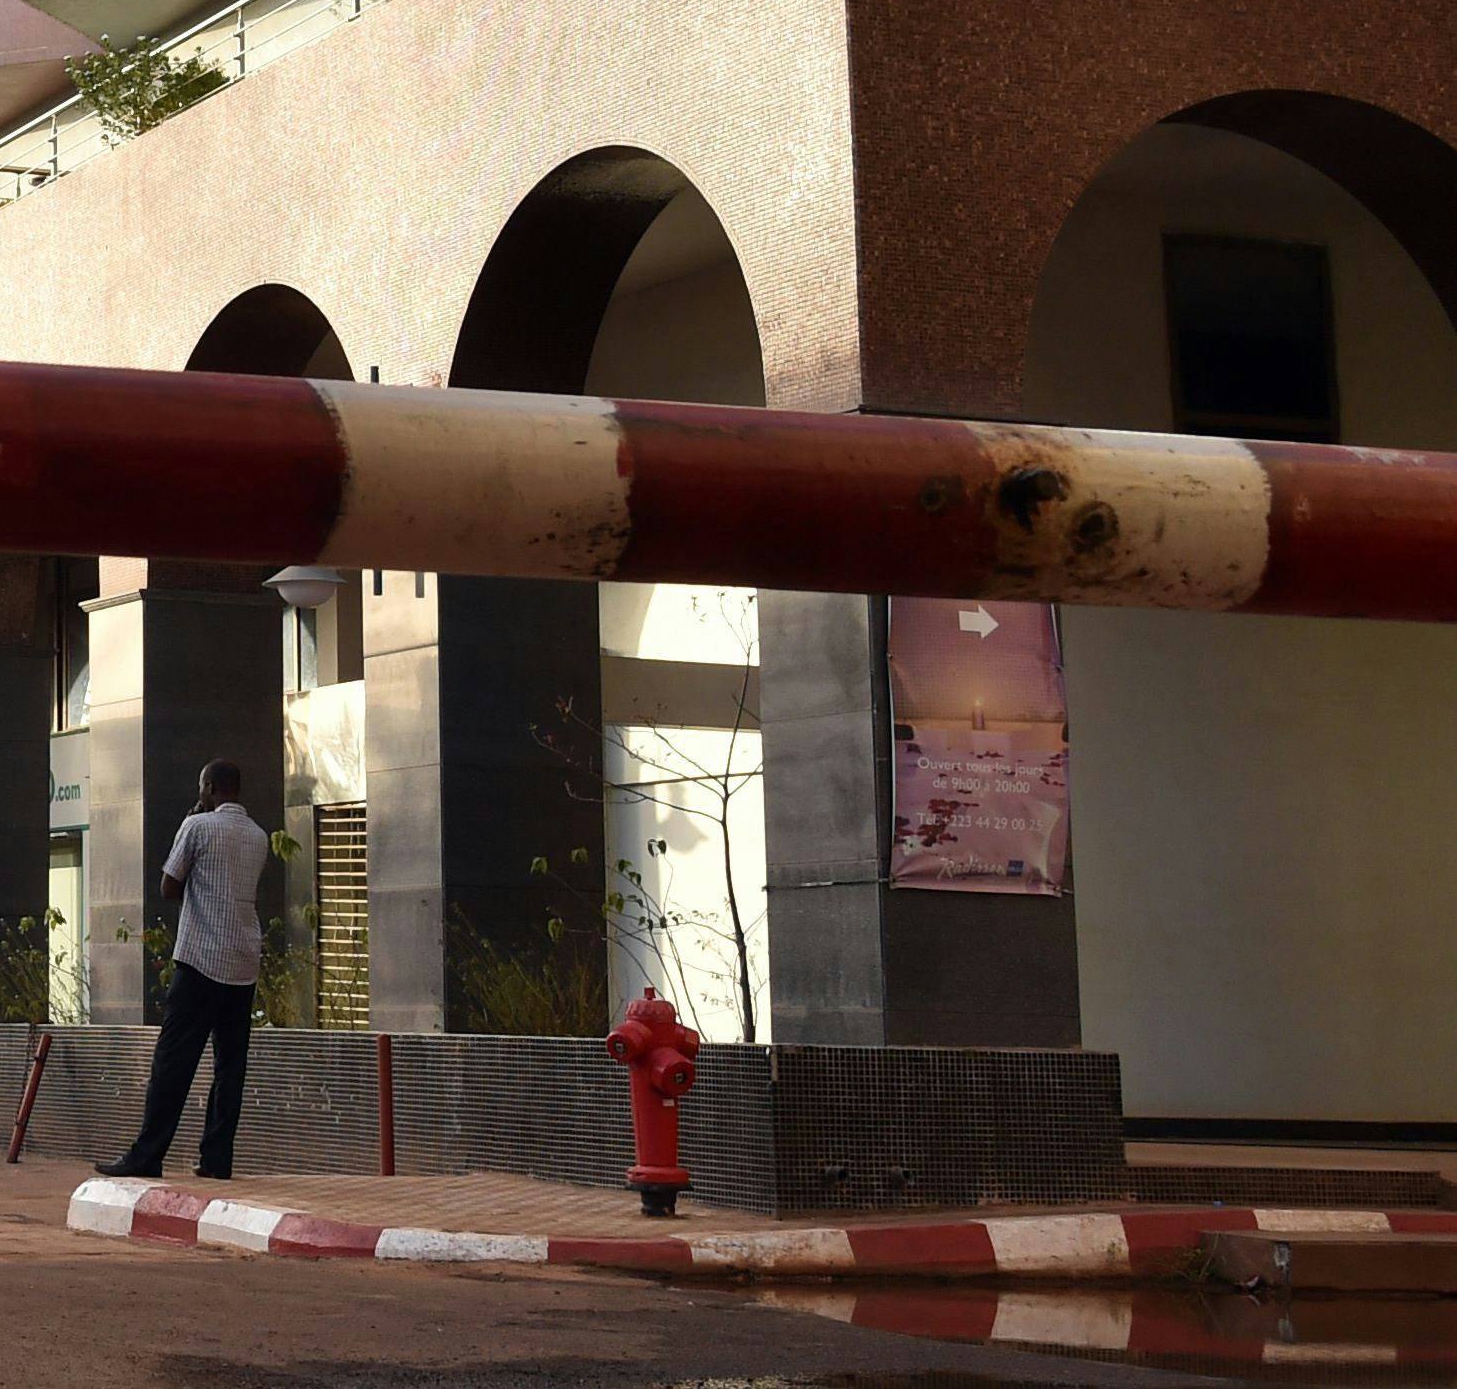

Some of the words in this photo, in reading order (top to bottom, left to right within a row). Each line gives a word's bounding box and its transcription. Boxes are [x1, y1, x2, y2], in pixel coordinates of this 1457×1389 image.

[917, 756, 962, 772] Ouvert
[966, 760, 991, 773] tous
[1015, 762, 1045, 777] jours
[932, 777, 948, 789] de
[951, 777, 981, 790] 9h00
[995, 780, 1030, 794] 20h00
[975, 816, 990, 829] 44
[994, 817, 1007, 830] 29
[1011, 818, 1026, 831] 00
